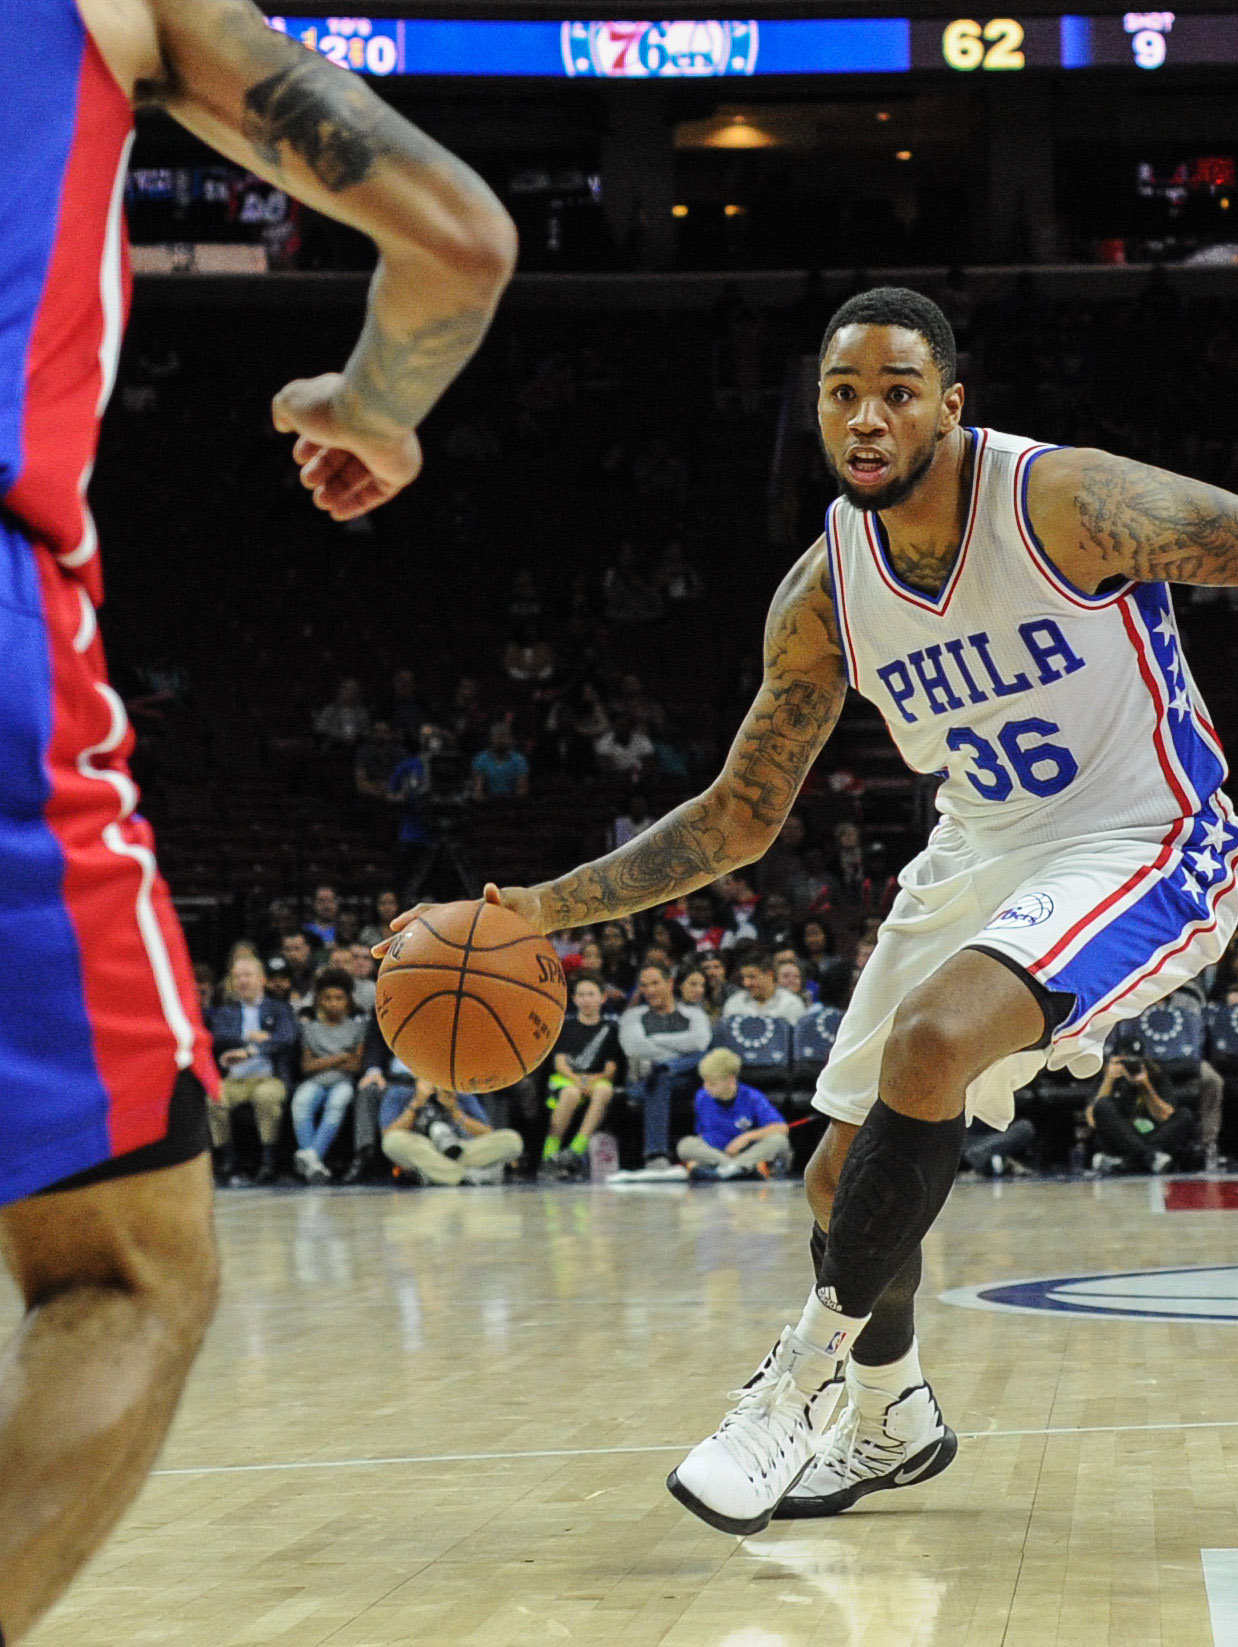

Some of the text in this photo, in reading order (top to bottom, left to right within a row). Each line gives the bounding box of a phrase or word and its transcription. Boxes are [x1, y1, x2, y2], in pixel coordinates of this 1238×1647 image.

[942, 18, 1025, 71] 62
[1132, 30, 1166, 69] 9
[876, 618, 1087, 724] PHILA
[946, 716, 1079, 802] 36
